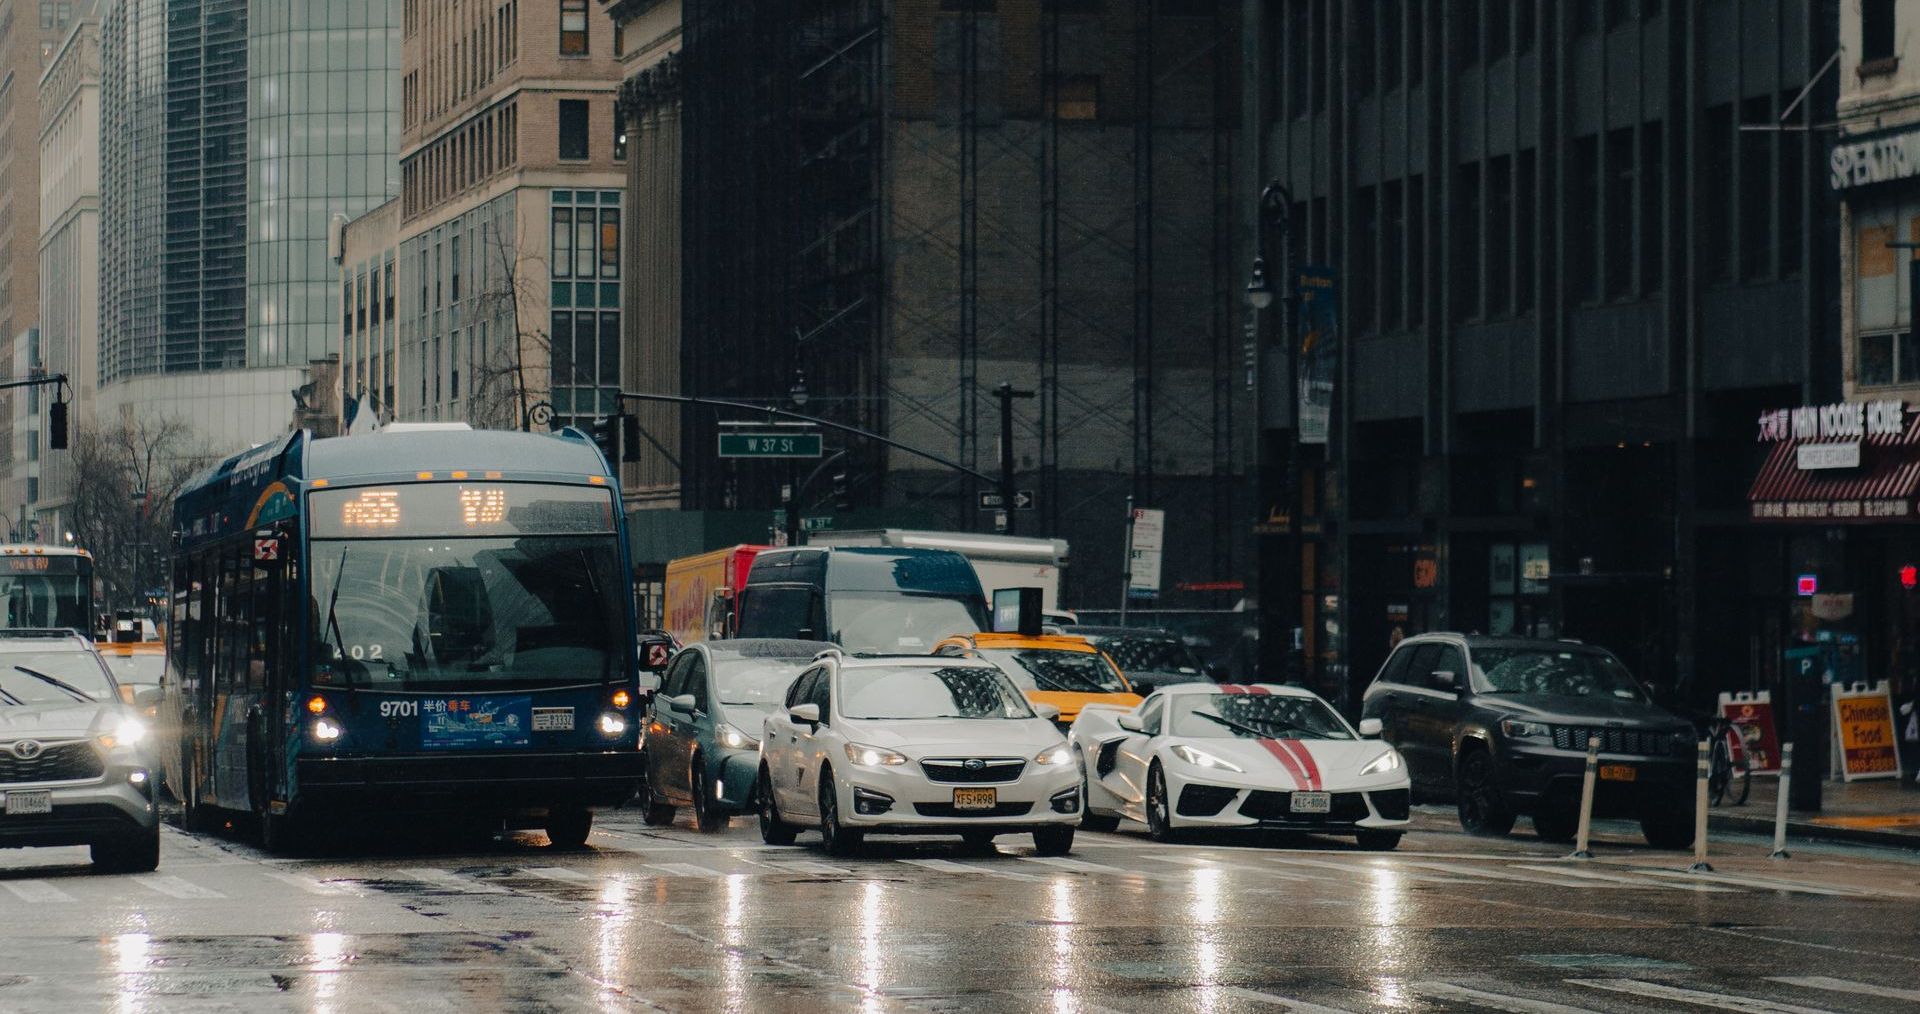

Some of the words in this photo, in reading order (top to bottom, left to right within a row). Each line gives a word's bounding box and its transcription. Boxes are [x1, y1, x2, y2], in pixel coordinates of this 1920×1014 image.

[1791, 404, 1818, 439] MAIN
[1819, 401, 1865, 438] NOODLE
[1867, 398, 1903, 434] HOUSE
[748, 439, 758, 452] W
[762, 439, 777, 452] 37
[781, 440, 795, 452] St
[380, 700, 419, 717] 9701
[1841, 703, 1889, 724] Chinese
[1852, 725, 1882, 745] Food
